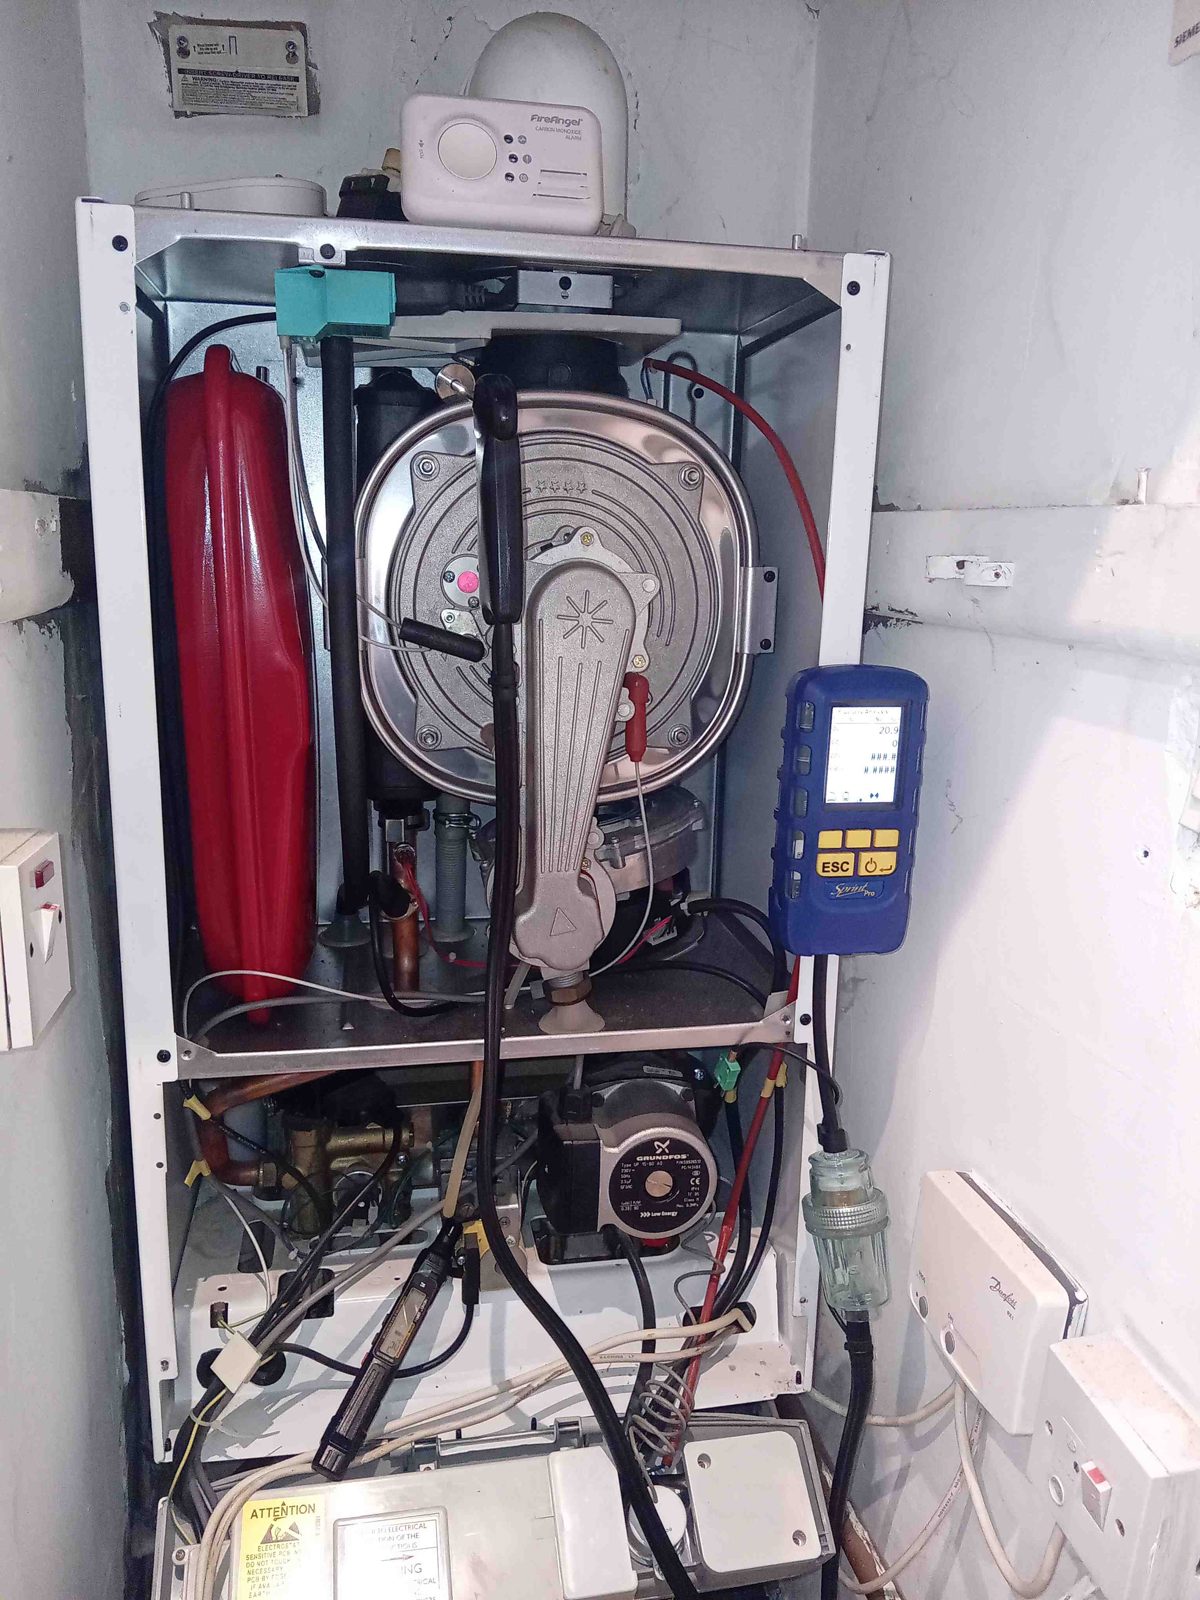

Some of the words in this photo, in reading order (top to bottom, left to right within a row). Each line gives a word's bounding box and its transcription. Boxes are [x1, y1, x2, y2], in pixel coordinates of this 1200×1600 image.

[879, 726, 899, 735] 20.9
[822, 862, 850, 873] ESC
[864, 889, 875, 897] Pro
[250, 1503, 316, 1519] ATTENTION
